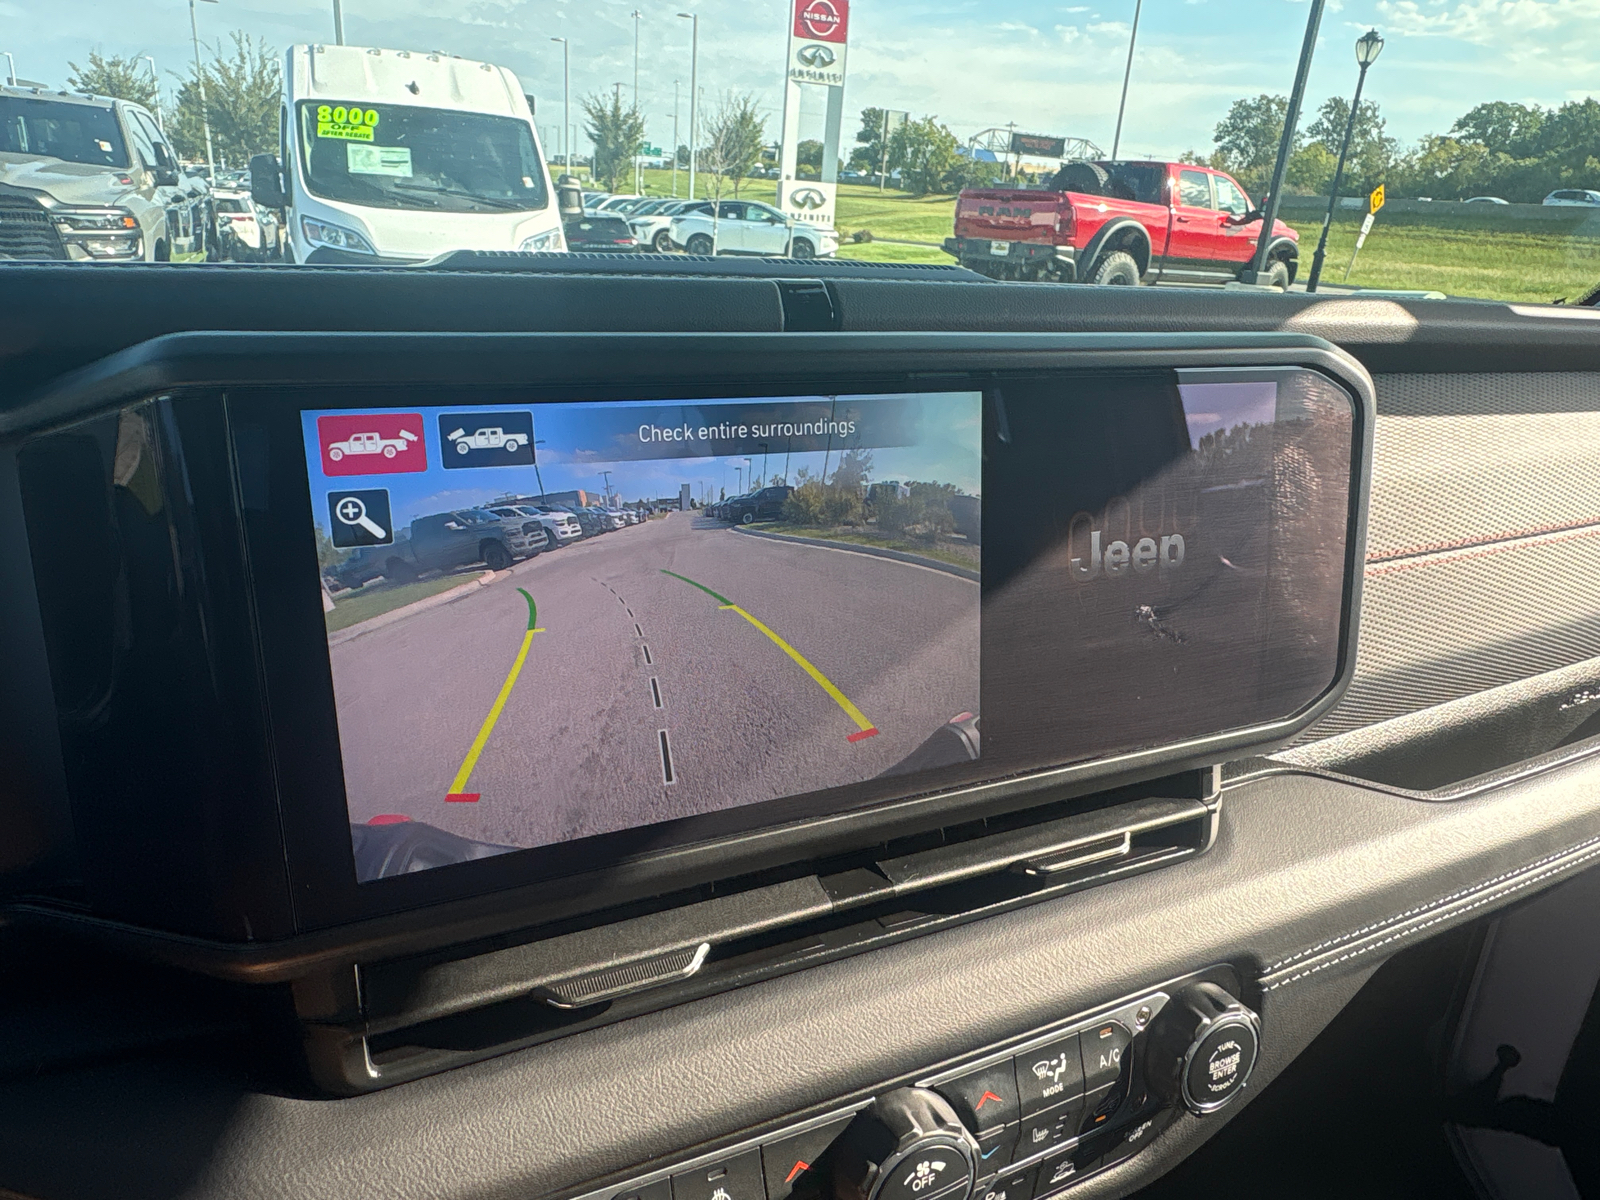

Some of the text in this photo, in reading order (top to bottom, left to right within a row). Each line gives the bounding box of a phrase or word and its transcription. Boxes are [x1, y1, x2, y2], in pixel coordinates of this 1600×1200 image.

[803, 11, 840, 24] NISSAN
[317, 105, 379, 127] 8000
[331, 123, 360, 131] OFF
[345, 131, 371, 140] REBATE
[784, 212, 831, 223] NFINITI
[979, 206, 1031, 218] RAM
[638, 418, 856, 443] Check entire surroundings
[1070, 530, 1185, 581] Jeep
[1217, 1040, 1235, 1053] TUNE
[1099, 1048, 1120, 1068] A/C
[1209, 1052, 1240, 1071] BROWSE
[1212, 1064, 1237, 1080] ENTER
[1042, 1083, 1064, 1098] MODE
[1210, 1078, 1235, 1091] SCROLL
[1128, 1130, 1144, 1142] OFF
[912, 1173, 936, 1191] OFF
